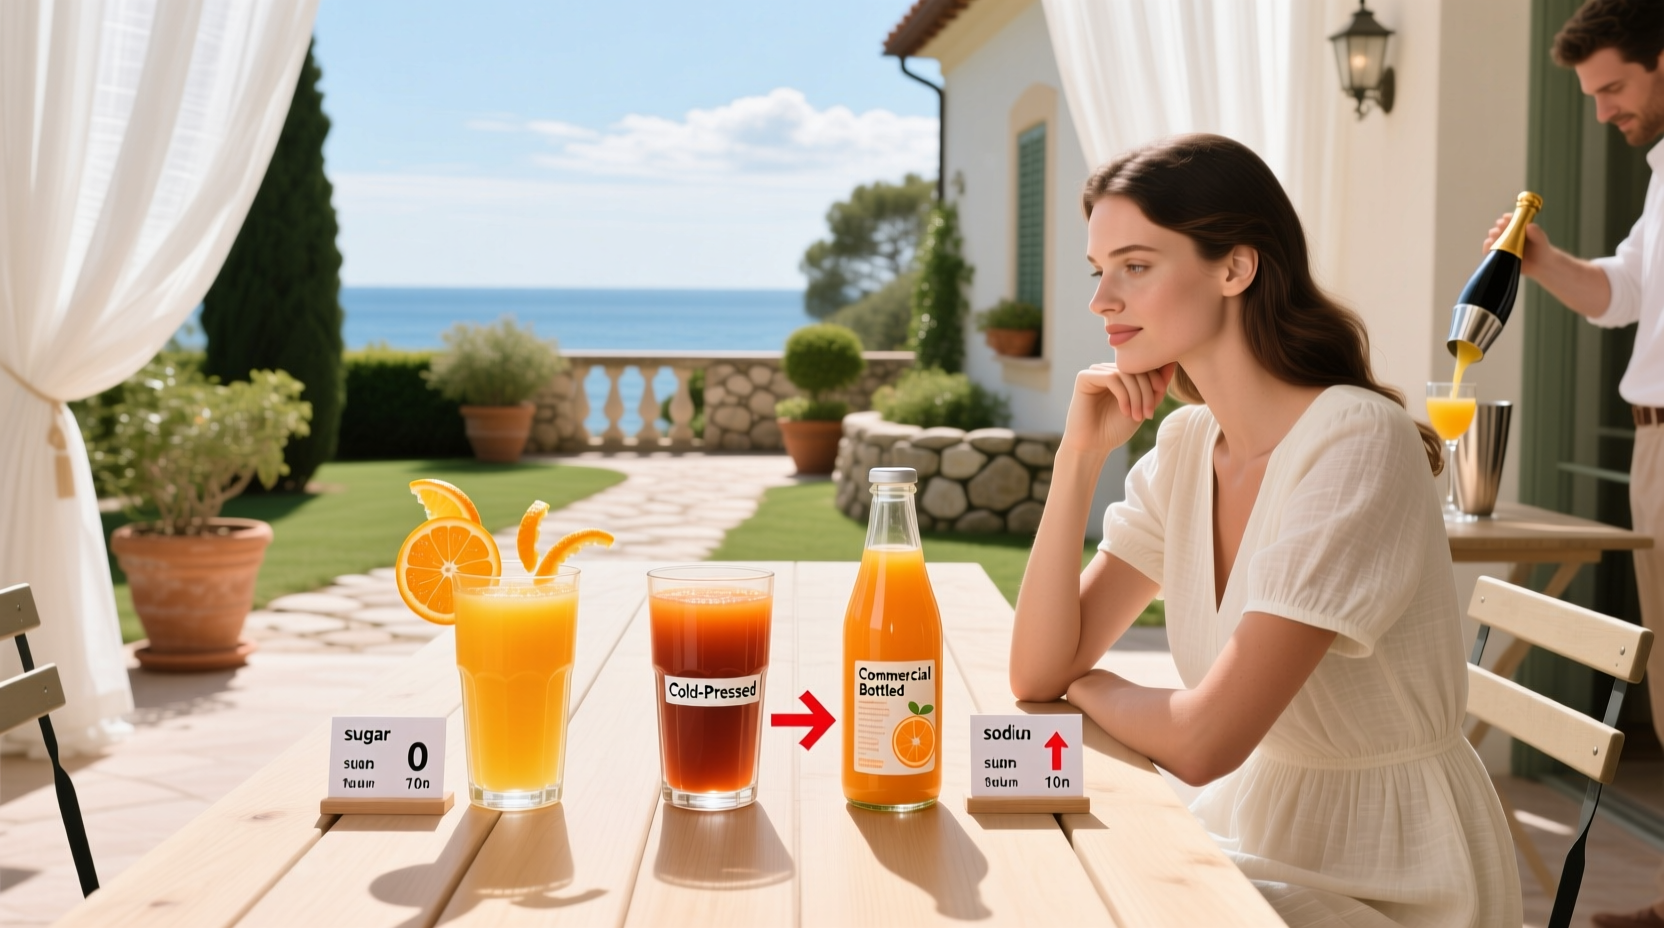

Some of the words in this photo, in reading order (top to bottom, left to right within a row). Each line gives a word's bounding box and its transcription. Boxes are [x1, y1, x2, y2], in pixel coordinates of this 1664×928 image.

[859, 666, 931, 681] Commercial
[669, 680, 757, 699] Cold-Pressed
[859, 683, 905, 696] Bottled
[344, 729, 391, 745] sugar
[407, 741, 428, 772] 0
